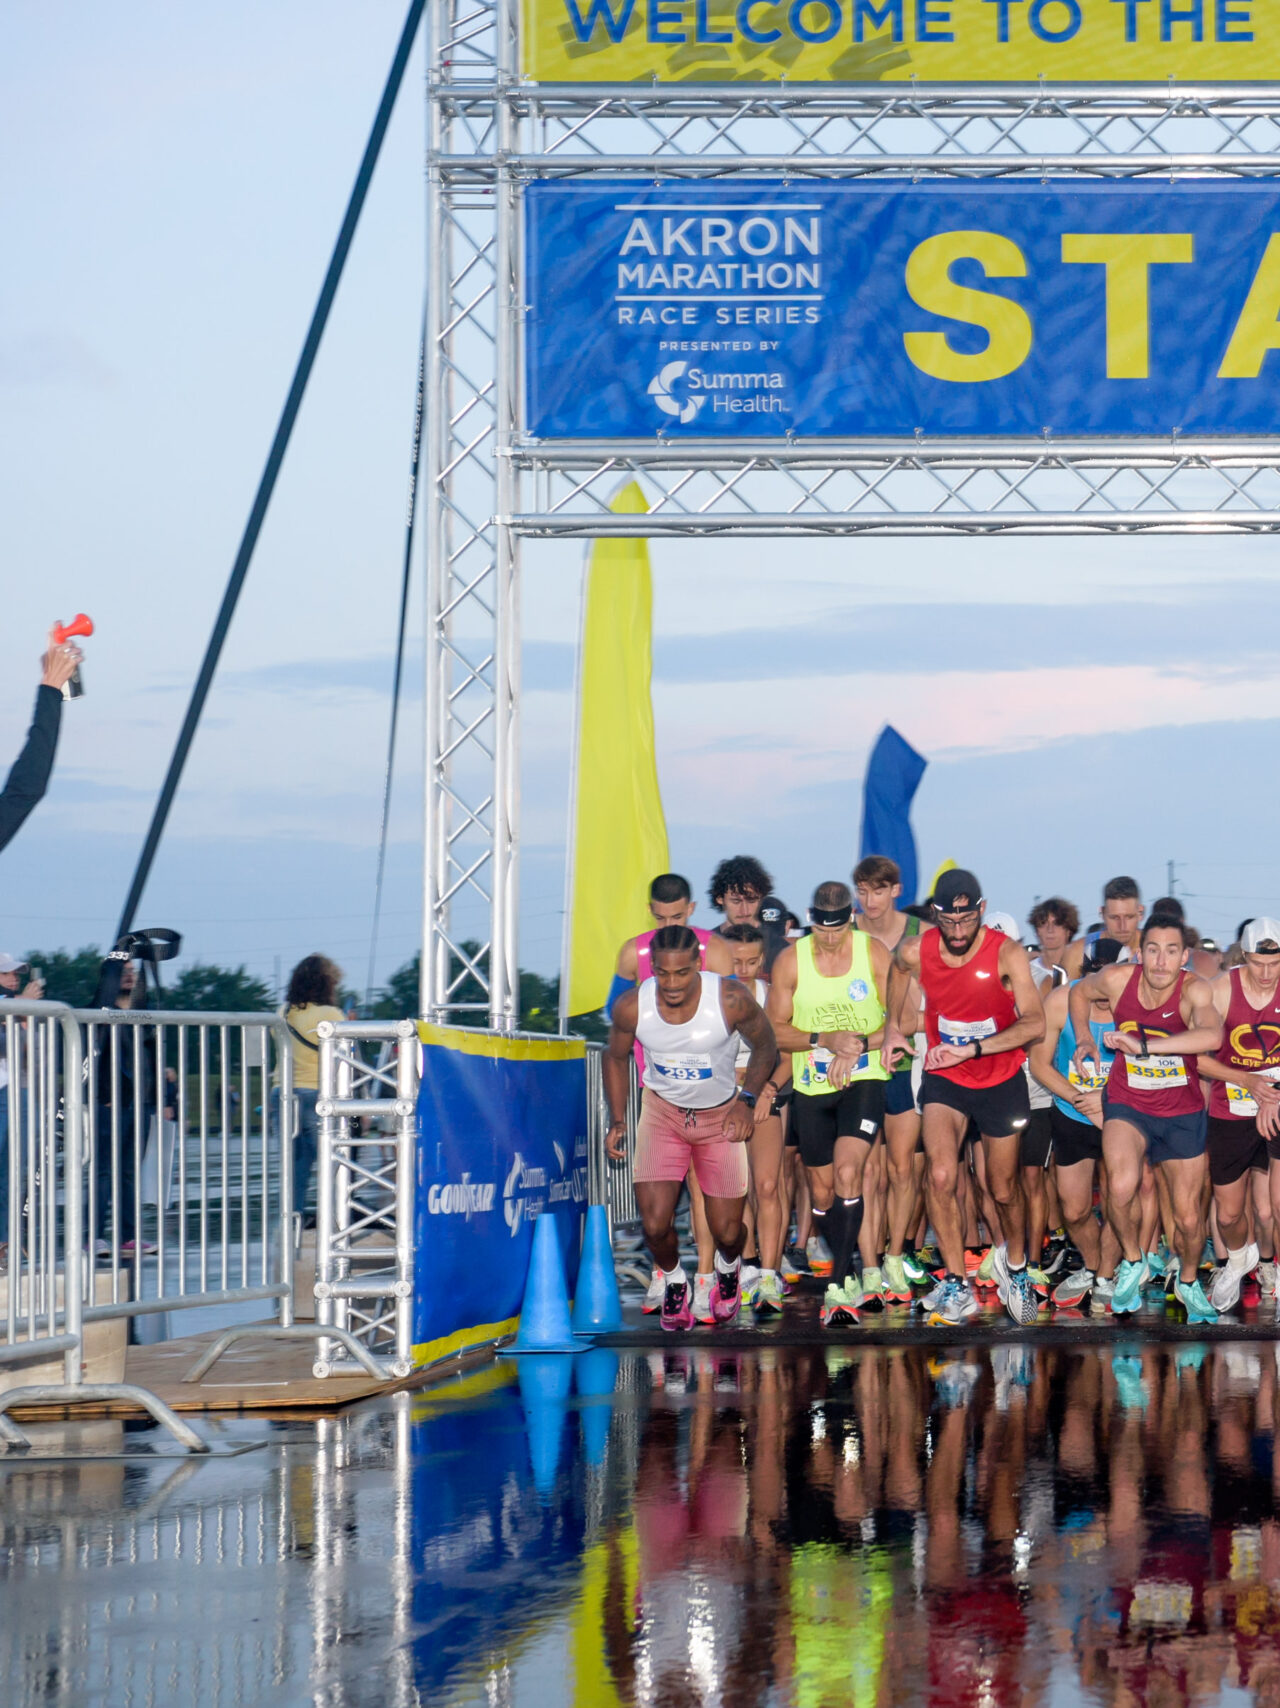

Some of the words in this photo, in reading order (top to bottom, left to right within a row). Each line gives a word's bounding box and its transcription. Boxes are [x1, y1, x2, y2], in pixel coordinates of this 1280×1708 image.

[565, 0, 955, 44] WELCOME
[981, 0, 1082, 44] TO
[1108, 0, 1255, 43] THE
[618, 217, 820, 256] AKRON
[617, 262, 820, 289] MARATHON
[617, 307, 698, 324] RACE
[716, 306, 821, 324] SERIES
[659, 341, 751, 351] PRESENTED
[759, 340, 780, 351] BY
[687, 368, 785, 390] Summa
[713, 394, 783, 413] Health
[664, 1067, 701, 1080] 293
[1074, 1074, 1107, 1087] 342
[1132, 1065, 1179, 1078] 3534
[1233, 1089, 1256, 1101] 34
[428, 1172, 496, 1223] GOODYEAR
